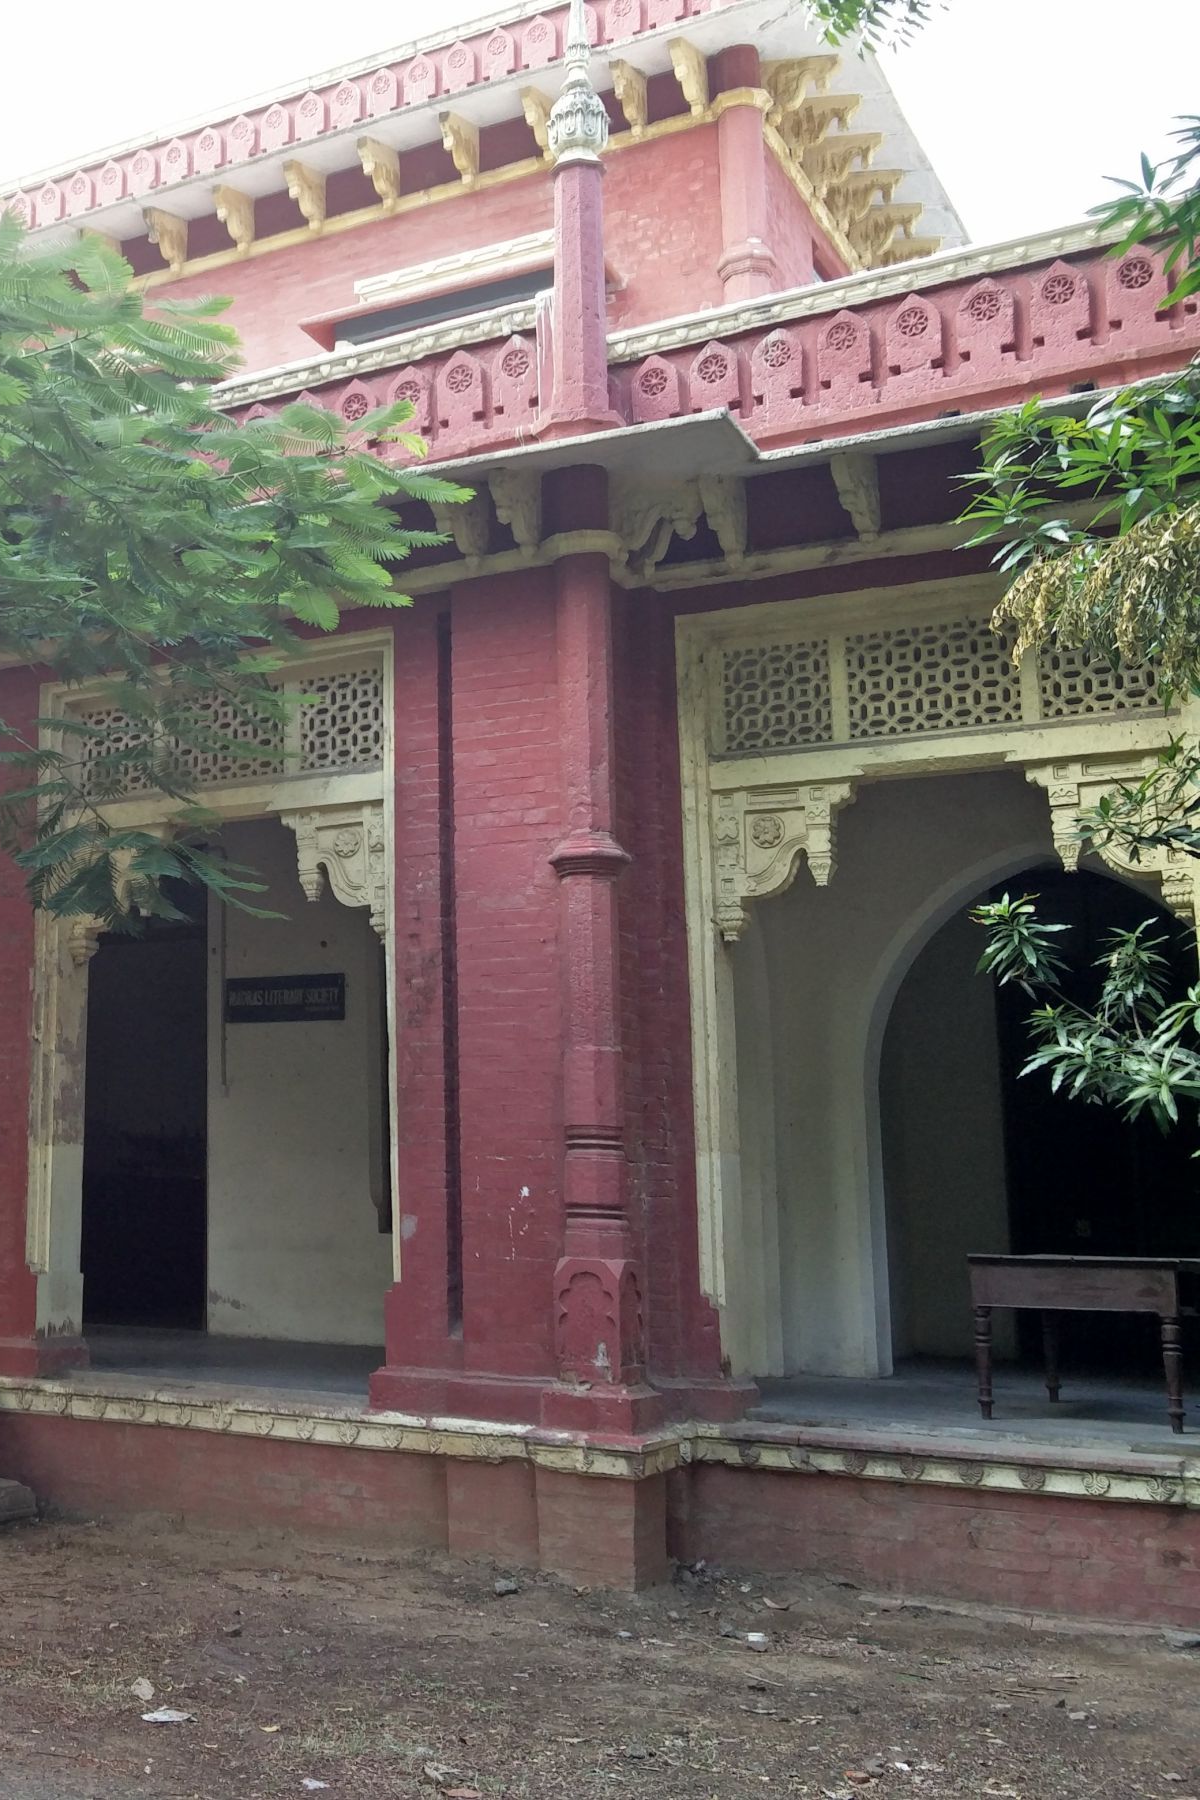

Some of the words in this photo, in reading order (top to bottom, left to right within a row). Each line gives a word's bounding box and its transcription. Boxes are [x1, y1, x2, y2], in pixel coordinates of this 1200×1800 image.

[228, 990, 263, 1006] MADRAS
[264, 989, 303, 1005] LITERARY
[304, 988, 339, 1004] SOCIETY
